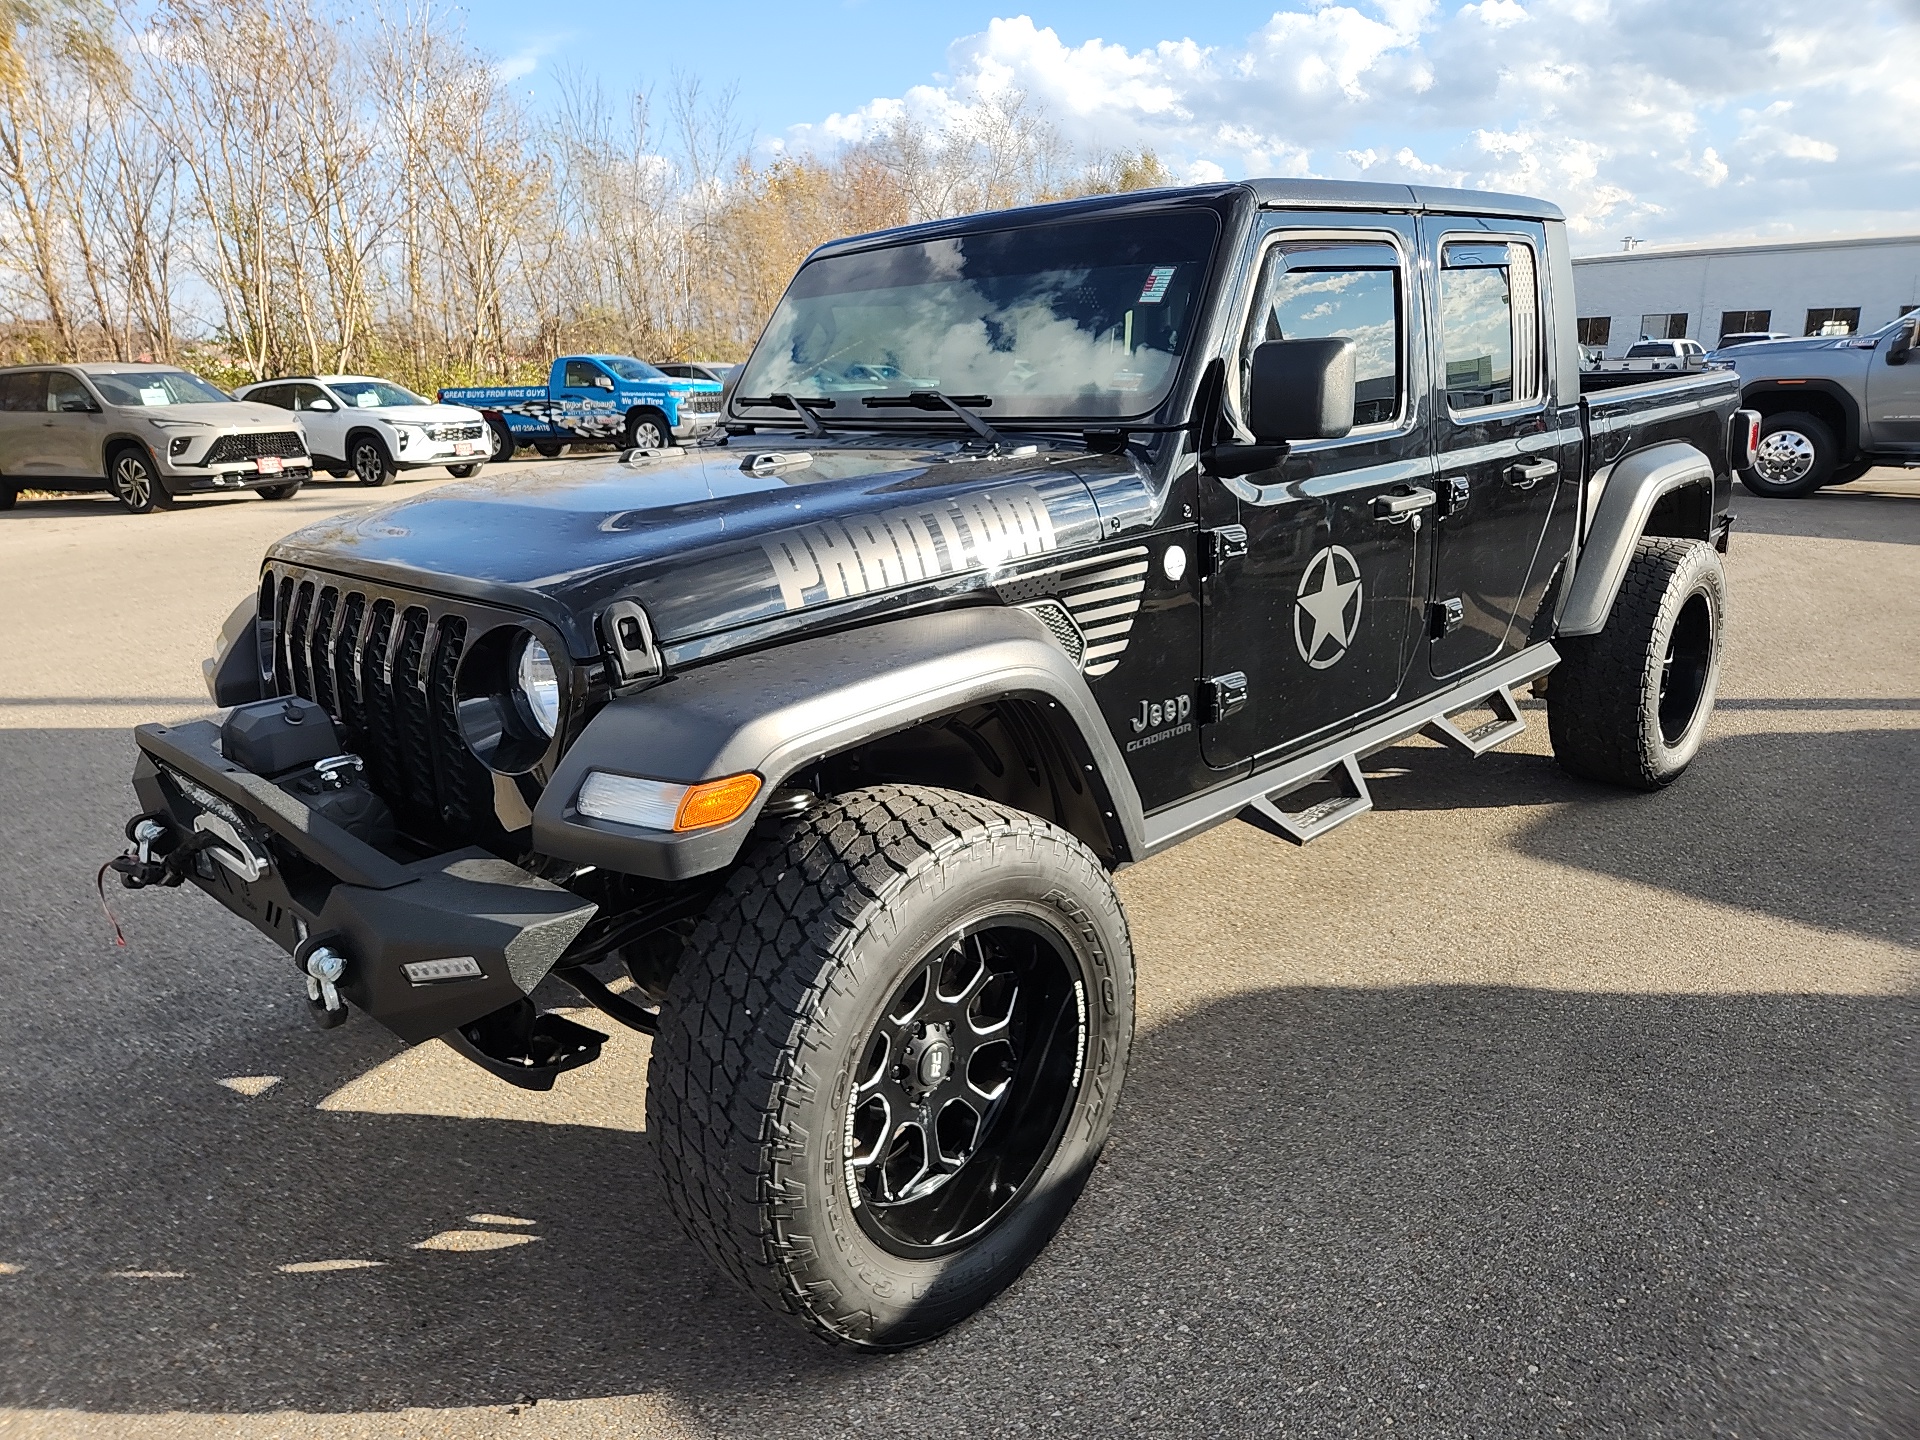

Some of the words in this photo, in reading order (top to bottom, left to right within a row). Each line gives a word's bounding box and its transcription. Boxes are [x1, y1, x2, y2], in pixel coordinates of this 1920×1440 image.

[444, 390, 466, 399] GREAT
[467, 390, 485, 399] BUYS
[486, 389, 506, 398] FROM
[508, 389, 524, 398] NICE
[526, 388, 546, 397] GUYS
[621, 397, 632, 405] We
[633, 397, 646, 406] Sell
[1130, 694, 1191, 734] Jeep
[1126, 723, 1192, 752] GLADIATOR
[1074, 979, 1086, 1023] ROUGH
[1072, 1024, 1086, 1088] COUNTRY
[844, 1081, 861, 1158] COUNTRY
[844, 1159, 861, 1209] ROUGH
